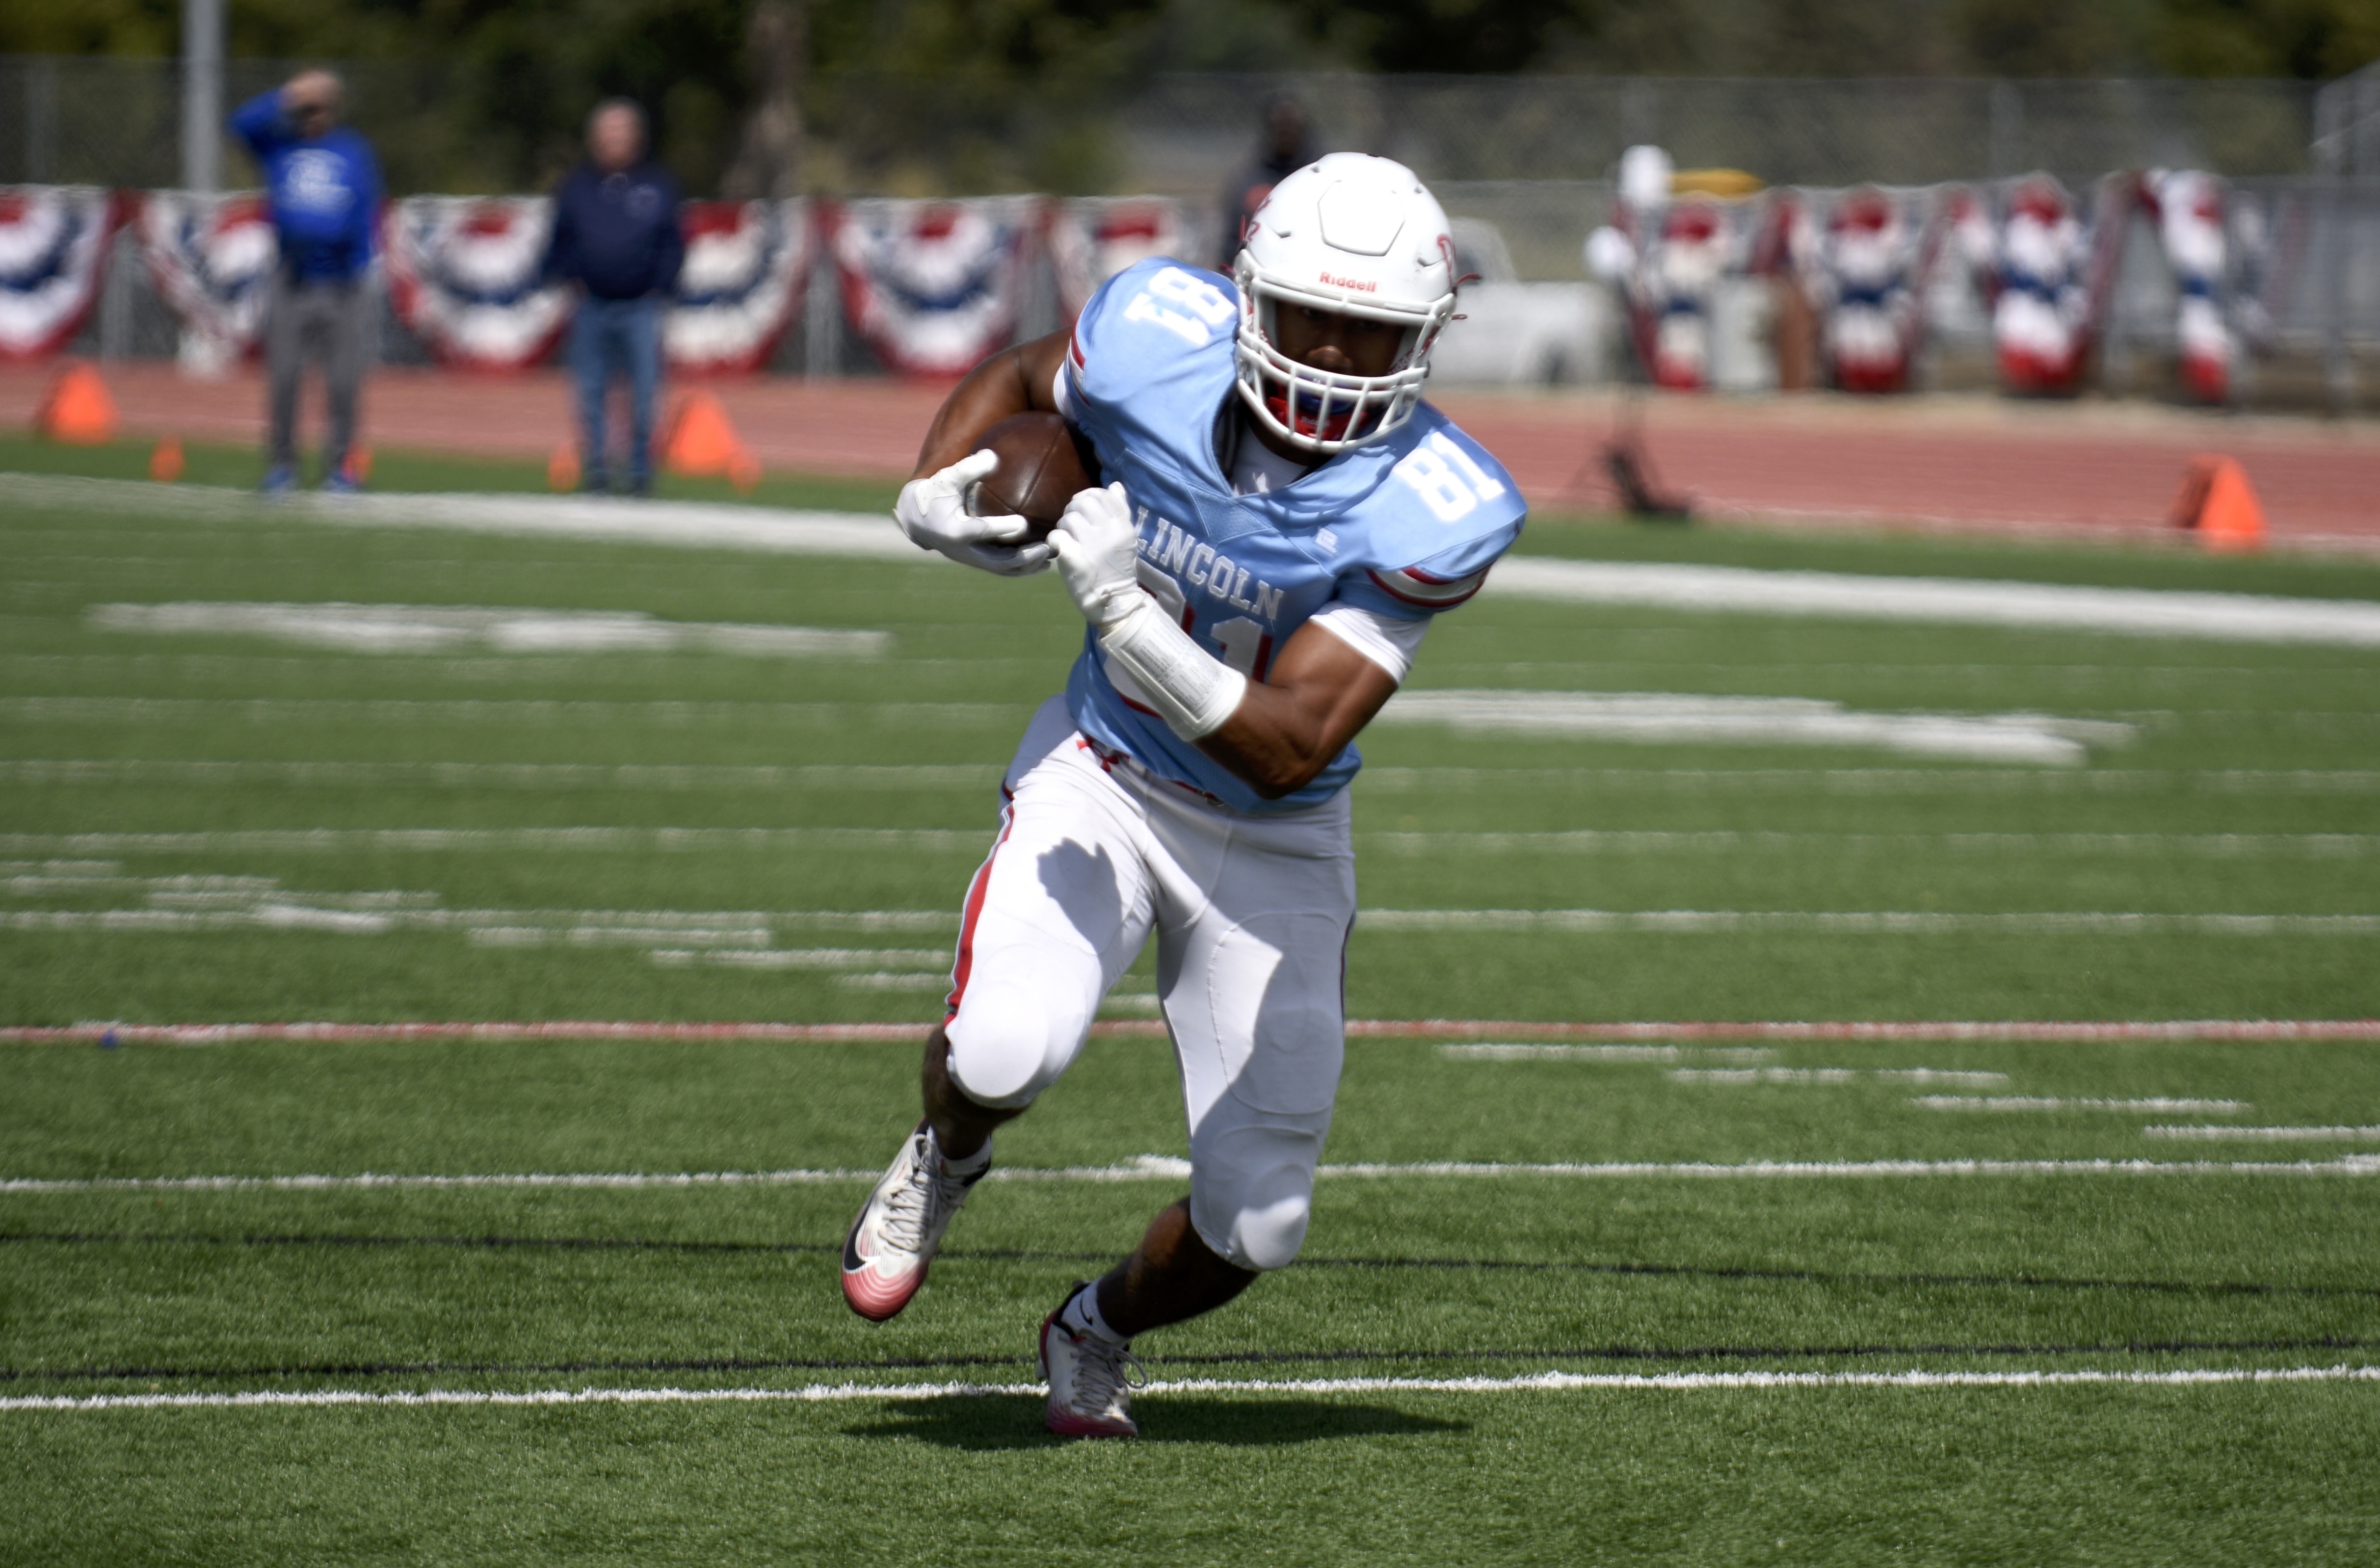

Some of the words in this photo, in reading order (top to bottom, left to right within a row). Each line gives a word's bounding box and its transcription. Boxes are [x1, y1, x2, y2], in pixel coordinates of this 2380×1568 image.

[1123, 266, 1238, 345] 81
[1320, 271, 1377, 292] Riddell
[1393, 431, 1506, 522] 81
[1137, 505, 1285, 620] LINCOLN
